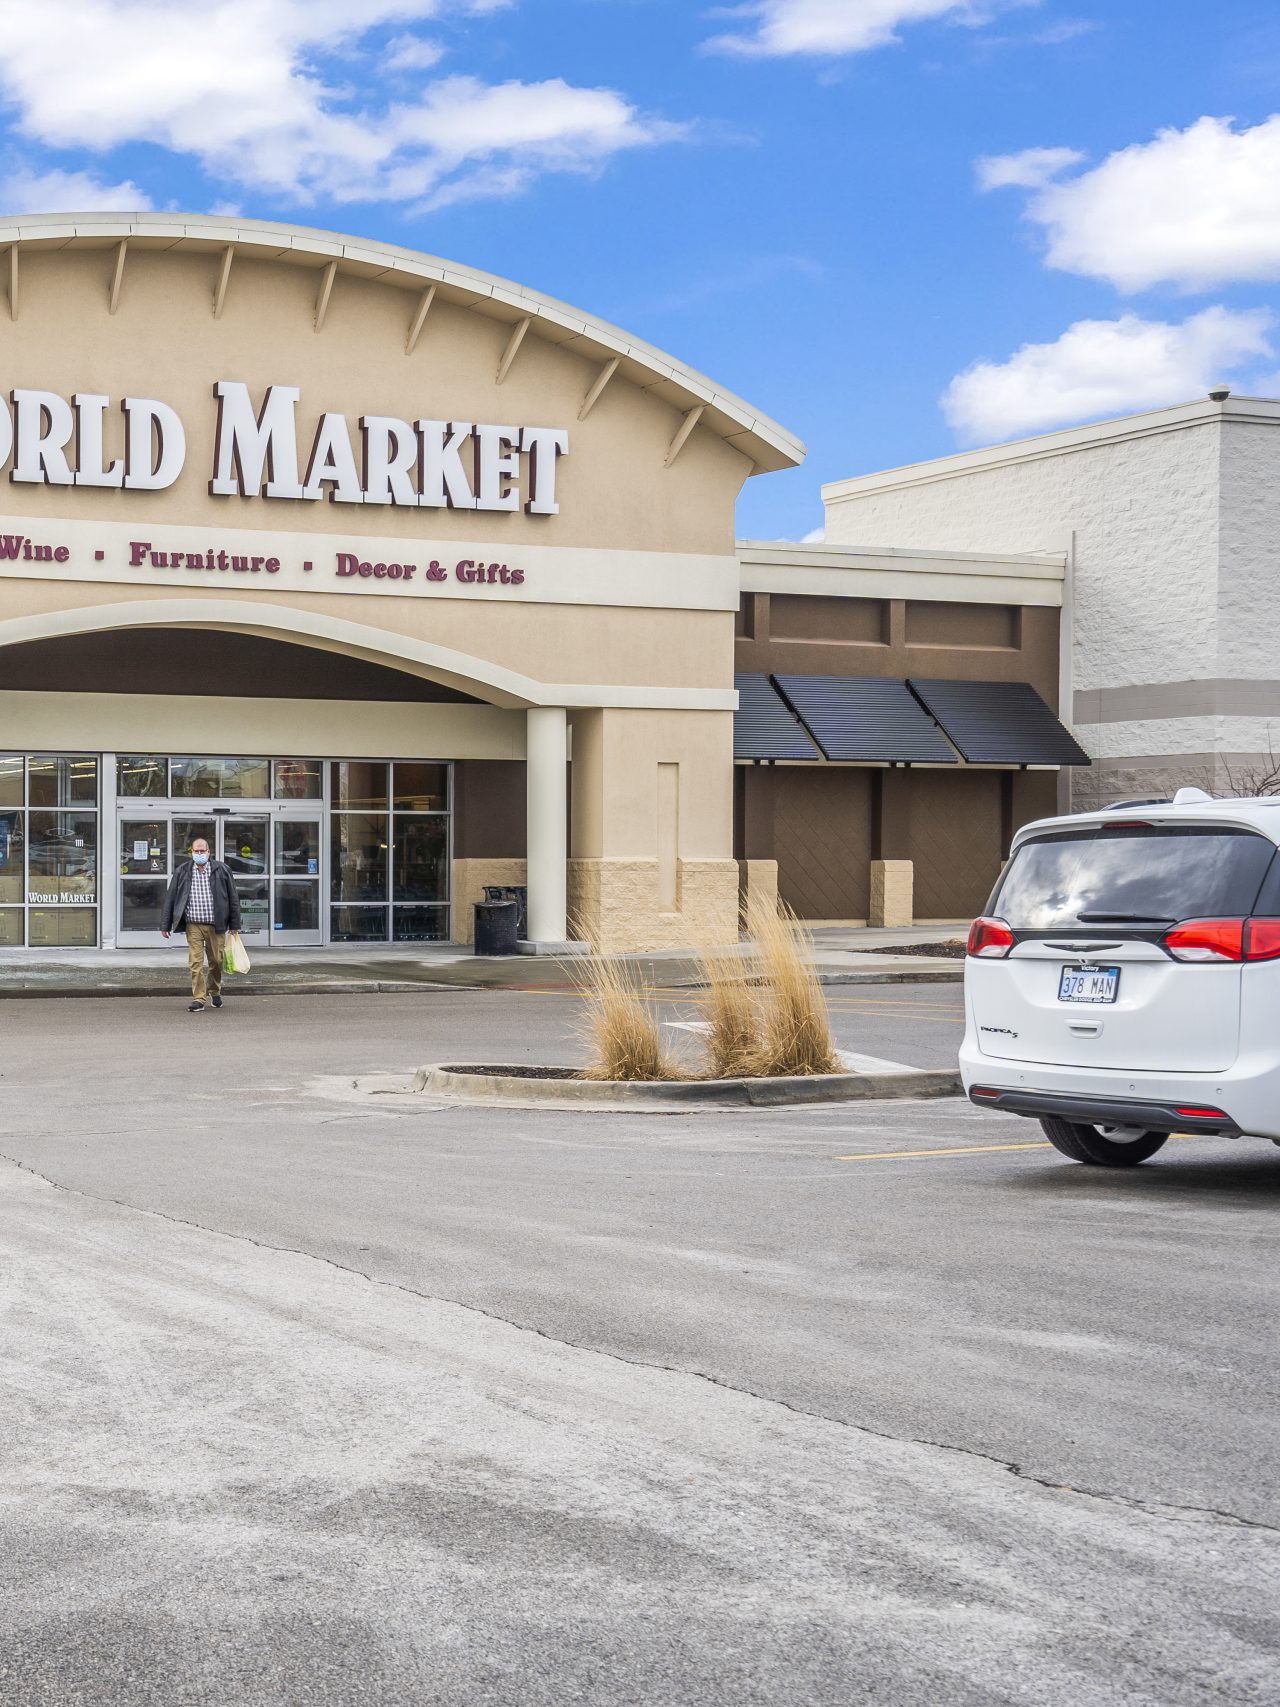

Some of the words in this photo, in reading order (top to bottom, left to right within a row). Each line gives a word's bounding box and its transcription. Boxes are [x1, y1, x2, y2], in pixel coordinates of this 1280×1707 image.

[208, 381, 569, 515] MARKET
[129, 541, 281, 573] Furniture
[335, 552, 417, 580] Decor
[425, 560, 448, 581] &
[455, 560, 525, 585] Gifts
[29, 892, 58, 903] WORLD
[60, 892, 95, 903] MARKET
[1063, 977, 1084, 993] 378
[1091, 977, 1113, 995] MAN
